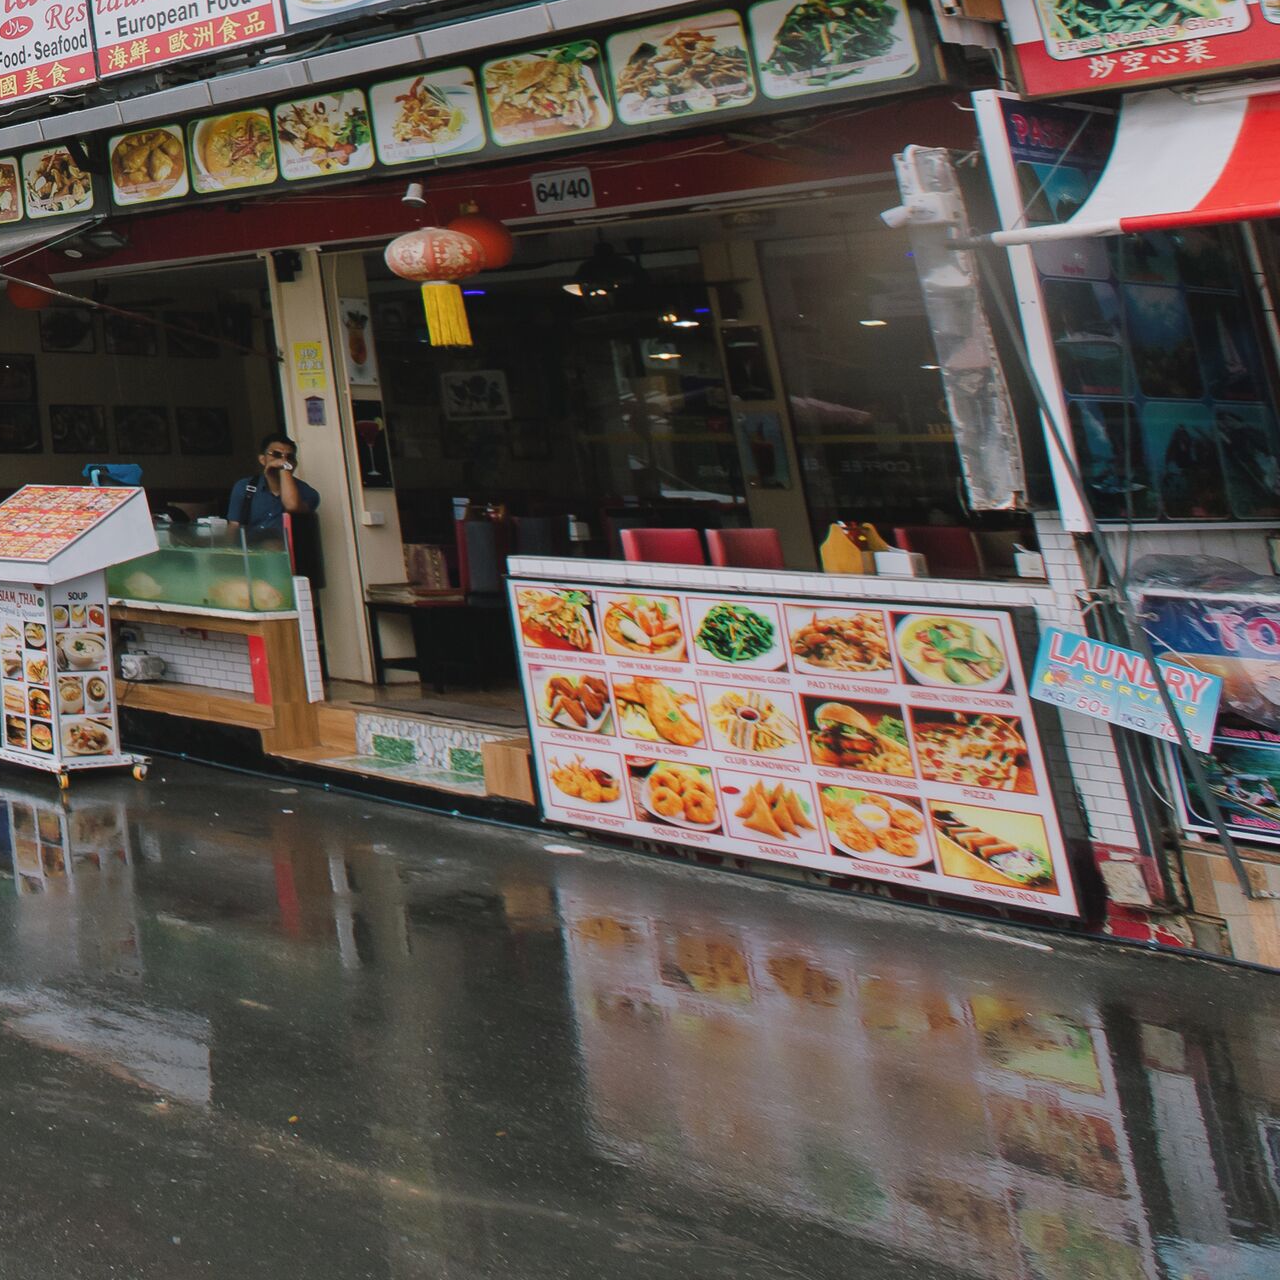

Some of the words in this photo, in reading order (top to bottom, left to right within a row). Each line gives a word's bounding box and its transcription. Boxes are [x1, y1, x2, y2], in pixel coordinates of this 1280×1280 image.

[33, 28, 88, 61] Seafood
[116, 0, 199, 38] European
[1055, 37, 1103, 53] Fried
[1105, 24, 1179, 46] Morning
[1182, 16, 1235, 32] Glory
[535, 177, 590, 203] 64/40
[18, 592, 37, 606] THAI
[67, 591, 88, 601] SOUP
[539, 653, 557, 661] CRAB
[558, 655, 578, 663] CURRY
[578, 657, 606, 666] POWDER
[617, 660, 635, 669] TOM
[635, 662, 653, 671] YAM
[653, 664, 683, 673] SHRIMP
[1048, 632, 1212, 704] LAUNDRY
[713, 670, 730, 679] FRIED
[731, 672, 766, 684] MORNING
[767, 675, 790, 685] GLORY
[806, 680, 826, 689] PAD
[828, 681, 850, 692] THAI
[851, 684, 890, 695] SHRIMP
[1083, 674, 1198, 716] SERVIE
[911, 691, 938, 701] GREEN
[941, 694, 969, 704] CURRY
[972, 697, 1014, 709] CHICKEN
[550, 731, 583, 742] CHICKEN
[584, 735, 611, 746] WINGS
[635, 743, 653, 753] FISH
[663, 747, 688, 757] CHIPS
[724, 756, 747, 766] CLUB
[750, 759, 801, 773] SANDWICH
[818, 769, 845, 780] CRISPY
[847, 773, 882, 786] CHICKEN
[884, 779, 919, 790] BURGER
[961, 789, 996, 801] PIZZA
[566, 811, 596, 822] SHRIMP
[598, 816, 626, 828] CRISPY
[652, 826, 679, 838] SQUID
[681, 830, 712, 843] CRISPY
[758, 845, 800, 860] SAMOSA
[852, 862, 890, 875] SHRIMP
[893, 869, 921, 882] CAKE
[972, 882, 1015, 899] SPRING
[1017, 891, 1048, 906] ROLL
